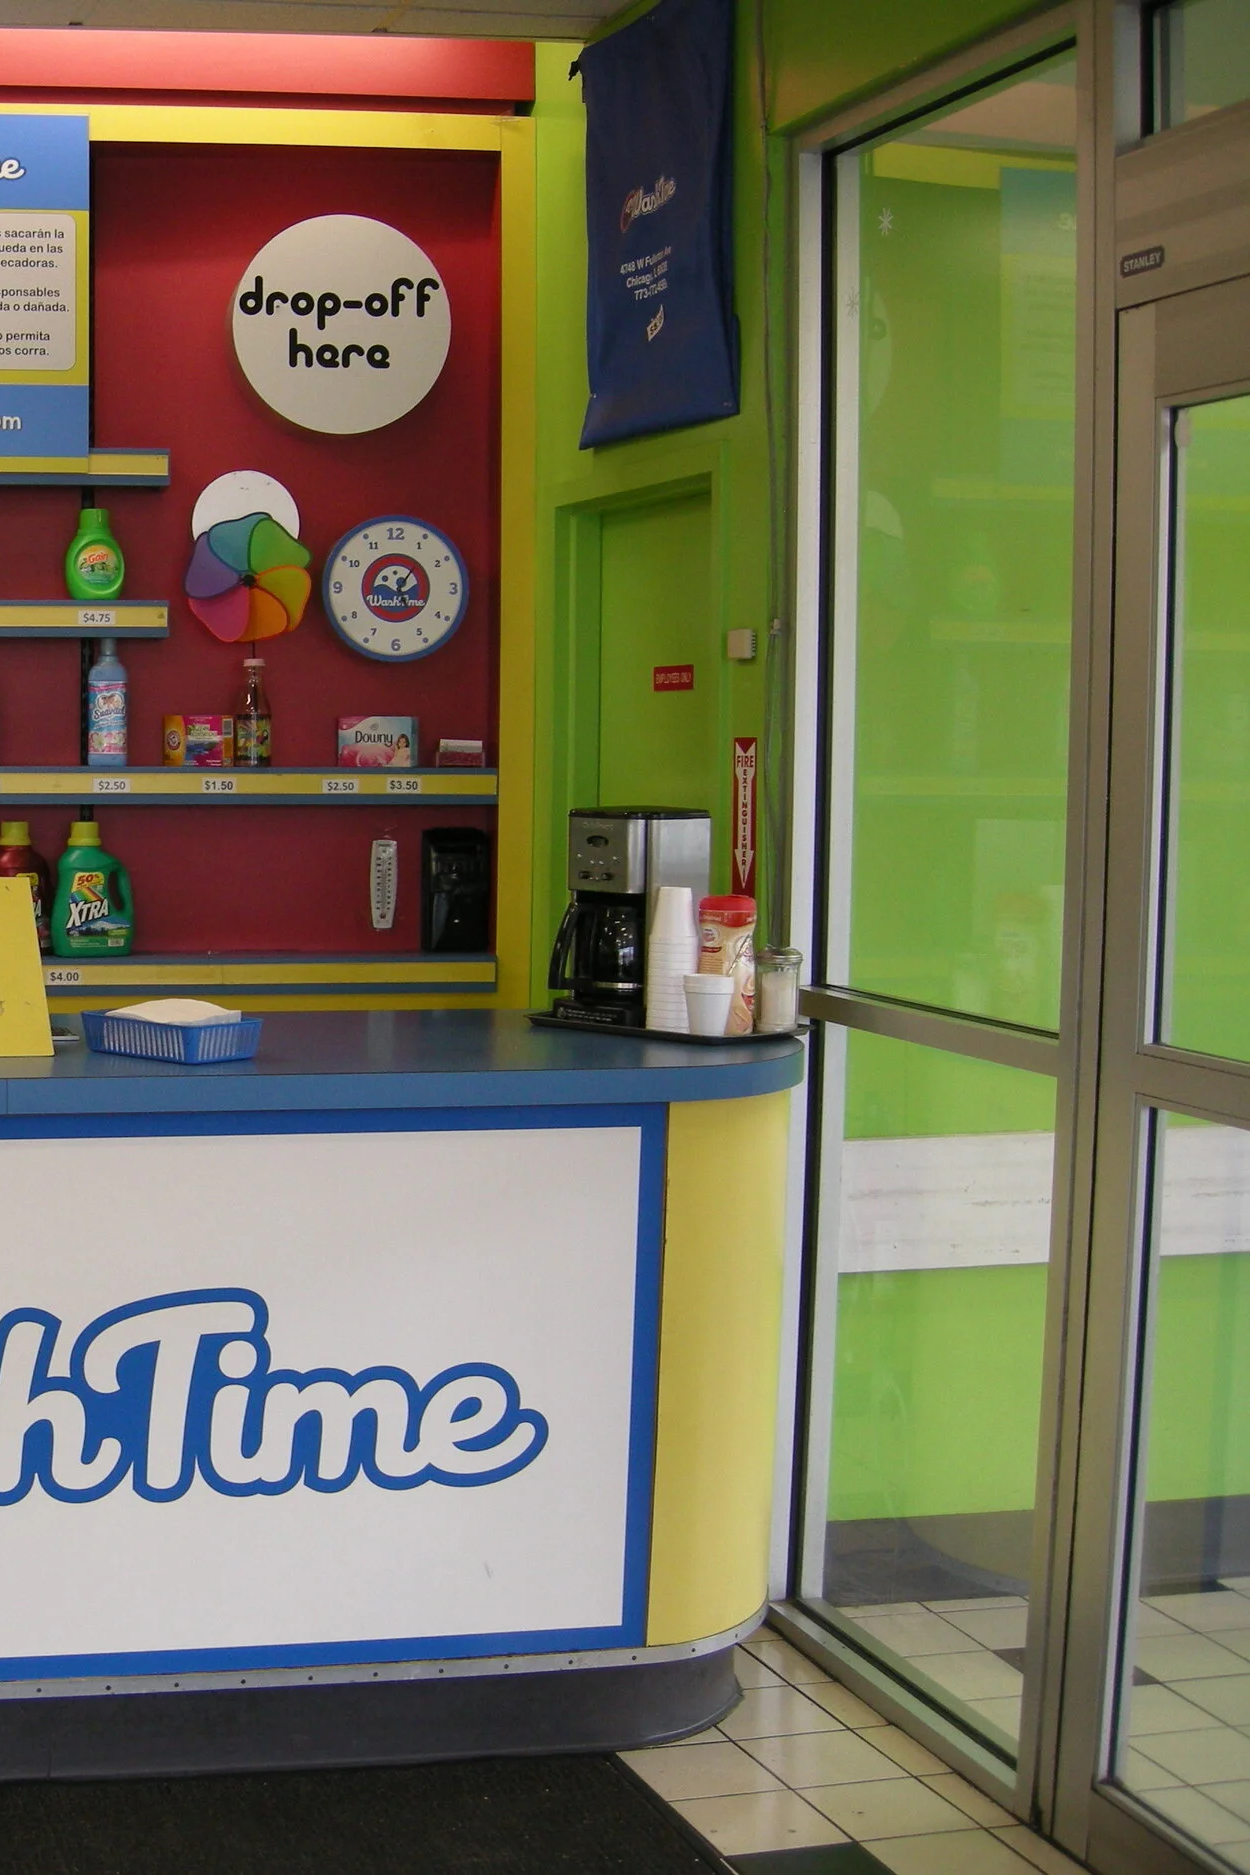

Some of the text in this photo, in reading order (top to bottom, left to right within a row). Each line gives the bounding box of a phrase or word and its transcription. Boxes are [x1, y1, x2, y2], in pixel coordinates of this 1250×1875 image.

[5, 229, 51, 238] sacarán
[54, 229, 64, 239] la
[30, 245, 43, 253] en
[47, 244, 63, 253] las
[1123, 252, 1161, 273] STANLEY
[23, 302, 69, 312] dañada.
[239, 275, 440, 330] drop-off
[6, 331, 50, 343] permita
[15, 345, 49, 355] corra.
[289, 328, 390, 369] here
[387, 528, 405, 540] 12
[369, 542, 379, 550] 11
[87, 553, 109, 565] Gain
[349, 560, 360, 568] 10
[435, 560, 441, 568] 2
[333, 581, 343, 594] 9
[449, 582, 458, 595] 3
[83, 612, 111, 624] $4.75
[351, 611, 358, 619] 8
[370, 628, 377, 636] 7
[416, 628, 423, 636] 5
[391, 639, 401, 651] 6
[355, 730, 393, 748] Downy
[737, 756, 754, 768] FIRE
[98, 780, 126, 791] $2.50
[204, 780, 233, 792] $1.50
[327, 781, 354, 792] $2.50
[390, 779, 418, 791] $3.50
[66, 899, 109, 929] XTRA
[50, 972, 79, 982] $4.00
